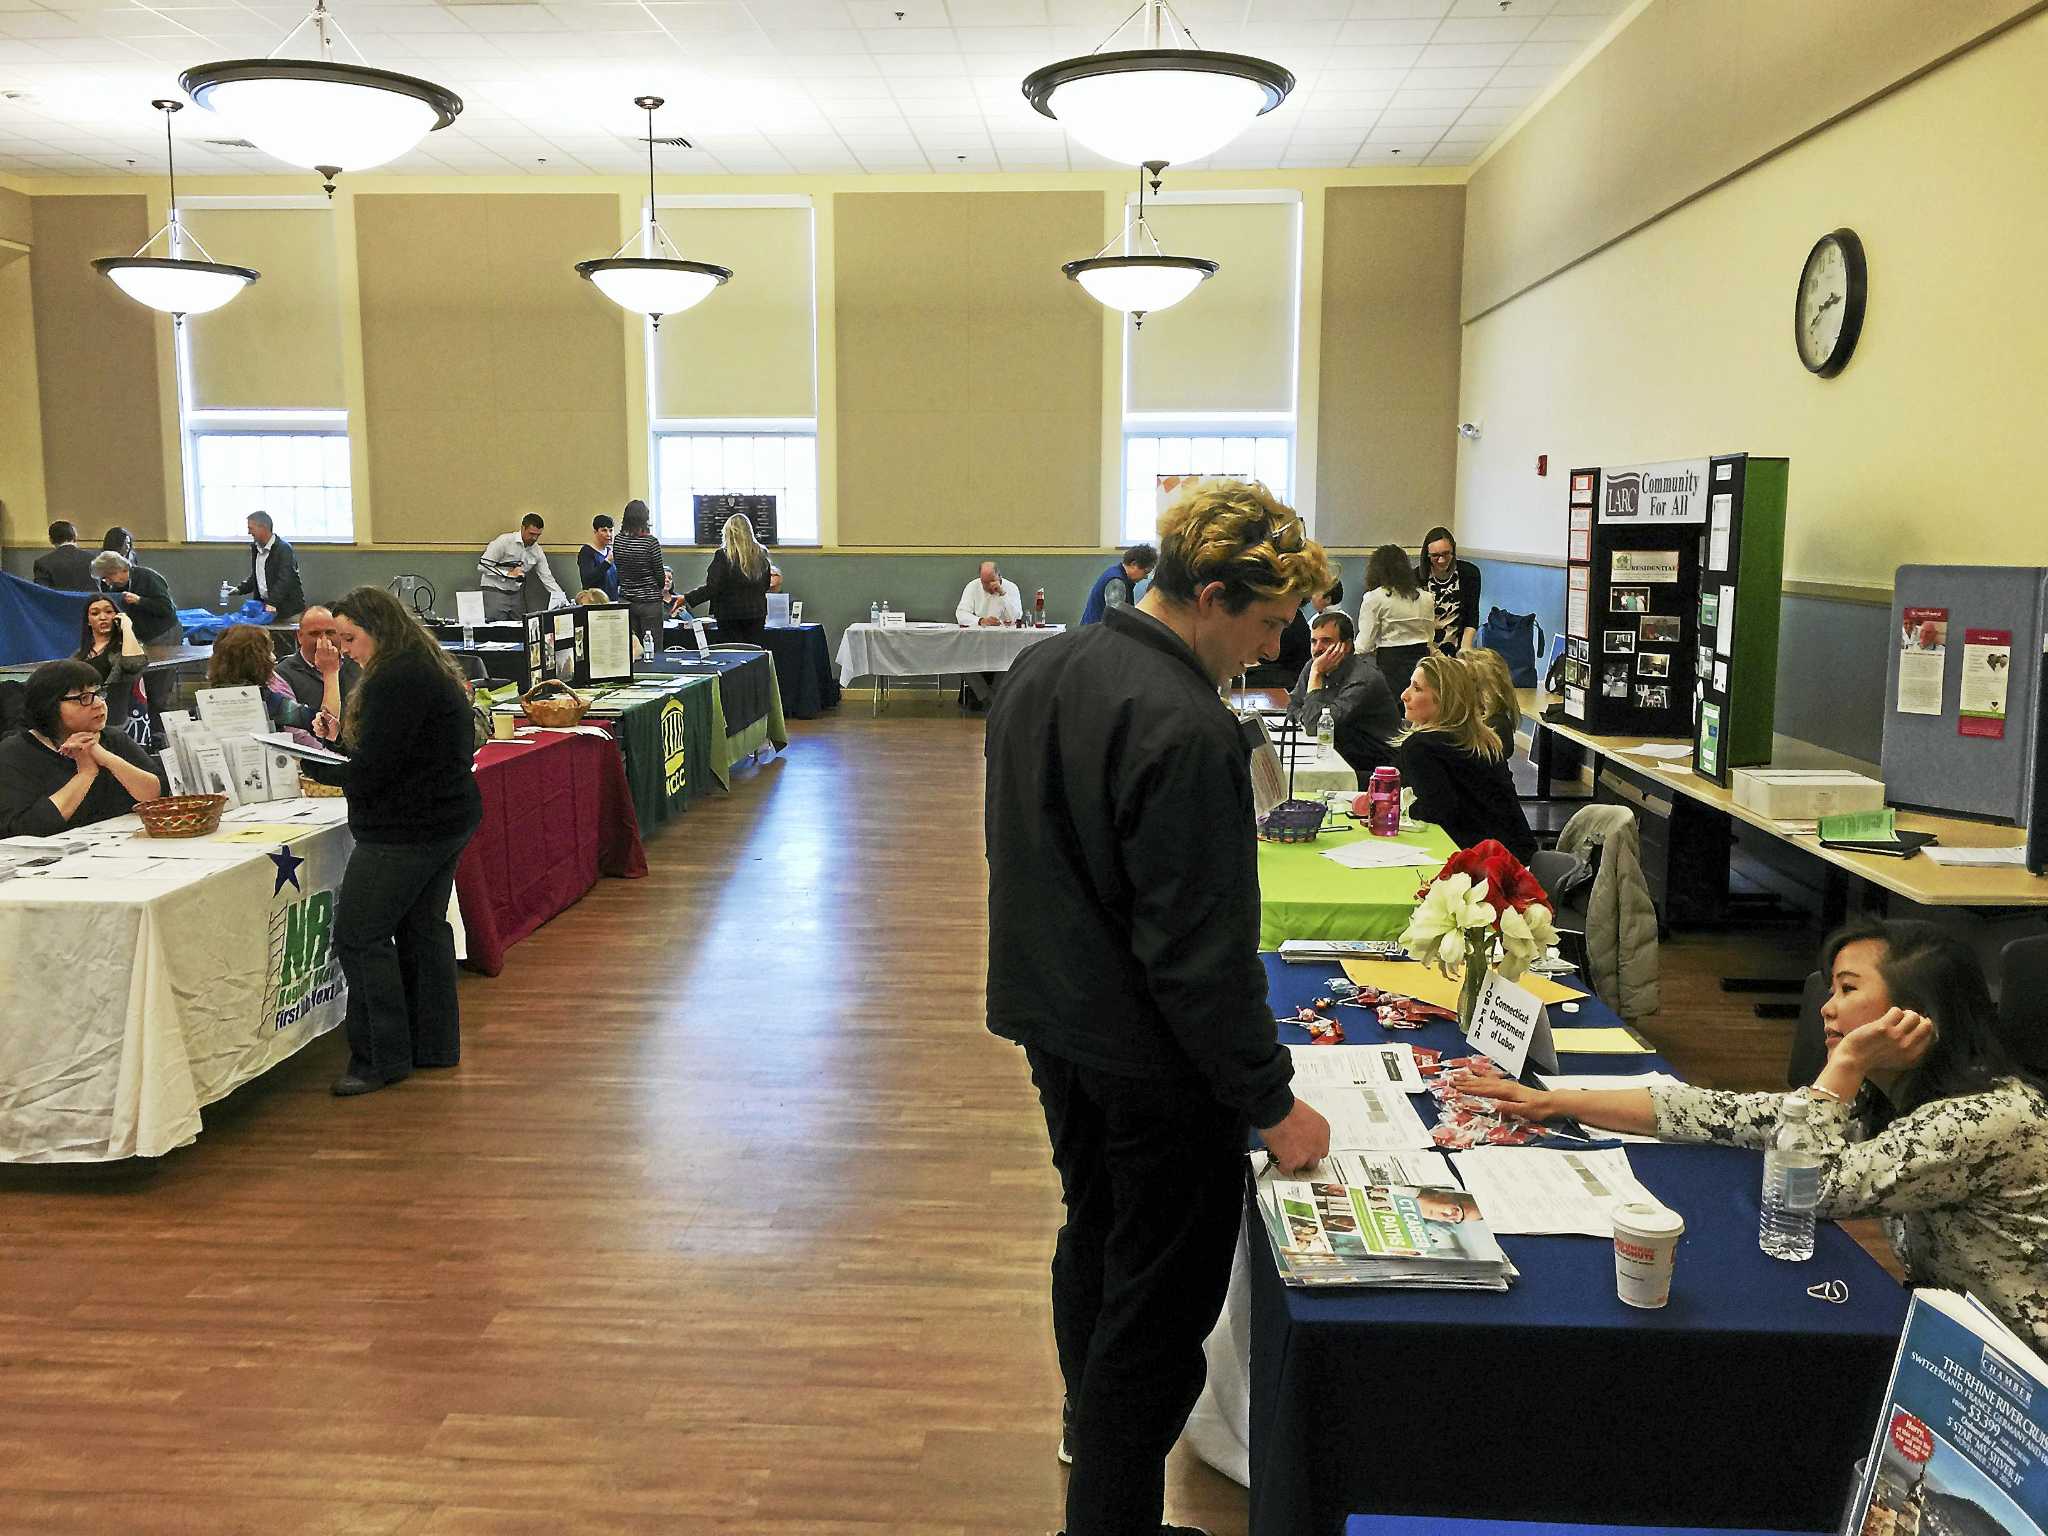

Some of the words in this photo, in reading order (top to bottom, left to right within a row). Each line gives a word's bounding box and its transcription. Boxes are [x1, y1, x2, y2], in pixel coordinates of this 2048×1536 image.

[1642, 469, 1699, 496] Community
[1608, 488, 1637, 513] LARC
[1650, 496, 1667, 516] For
[1671, 495, 1689, 516] All
[1484, 982, 1494, 1006] JOB
[1474, 1008, 1487, 1040] FAIR
[1495, 996, 1529, 1025] Connecticut
[1489, 1010, 1526, 1041] Department
[1490, 1030, 1499, 1041] of
[1497, 1033, 1516, 1052] Labor
[1943, 1355, 1965, 1381] THE
[1963, 1371, 1997, 1405] RHINE
[1995, 1395, 2024, 1428] RIVER
[1982, 1360, 2033, 1404] CHAMBER
